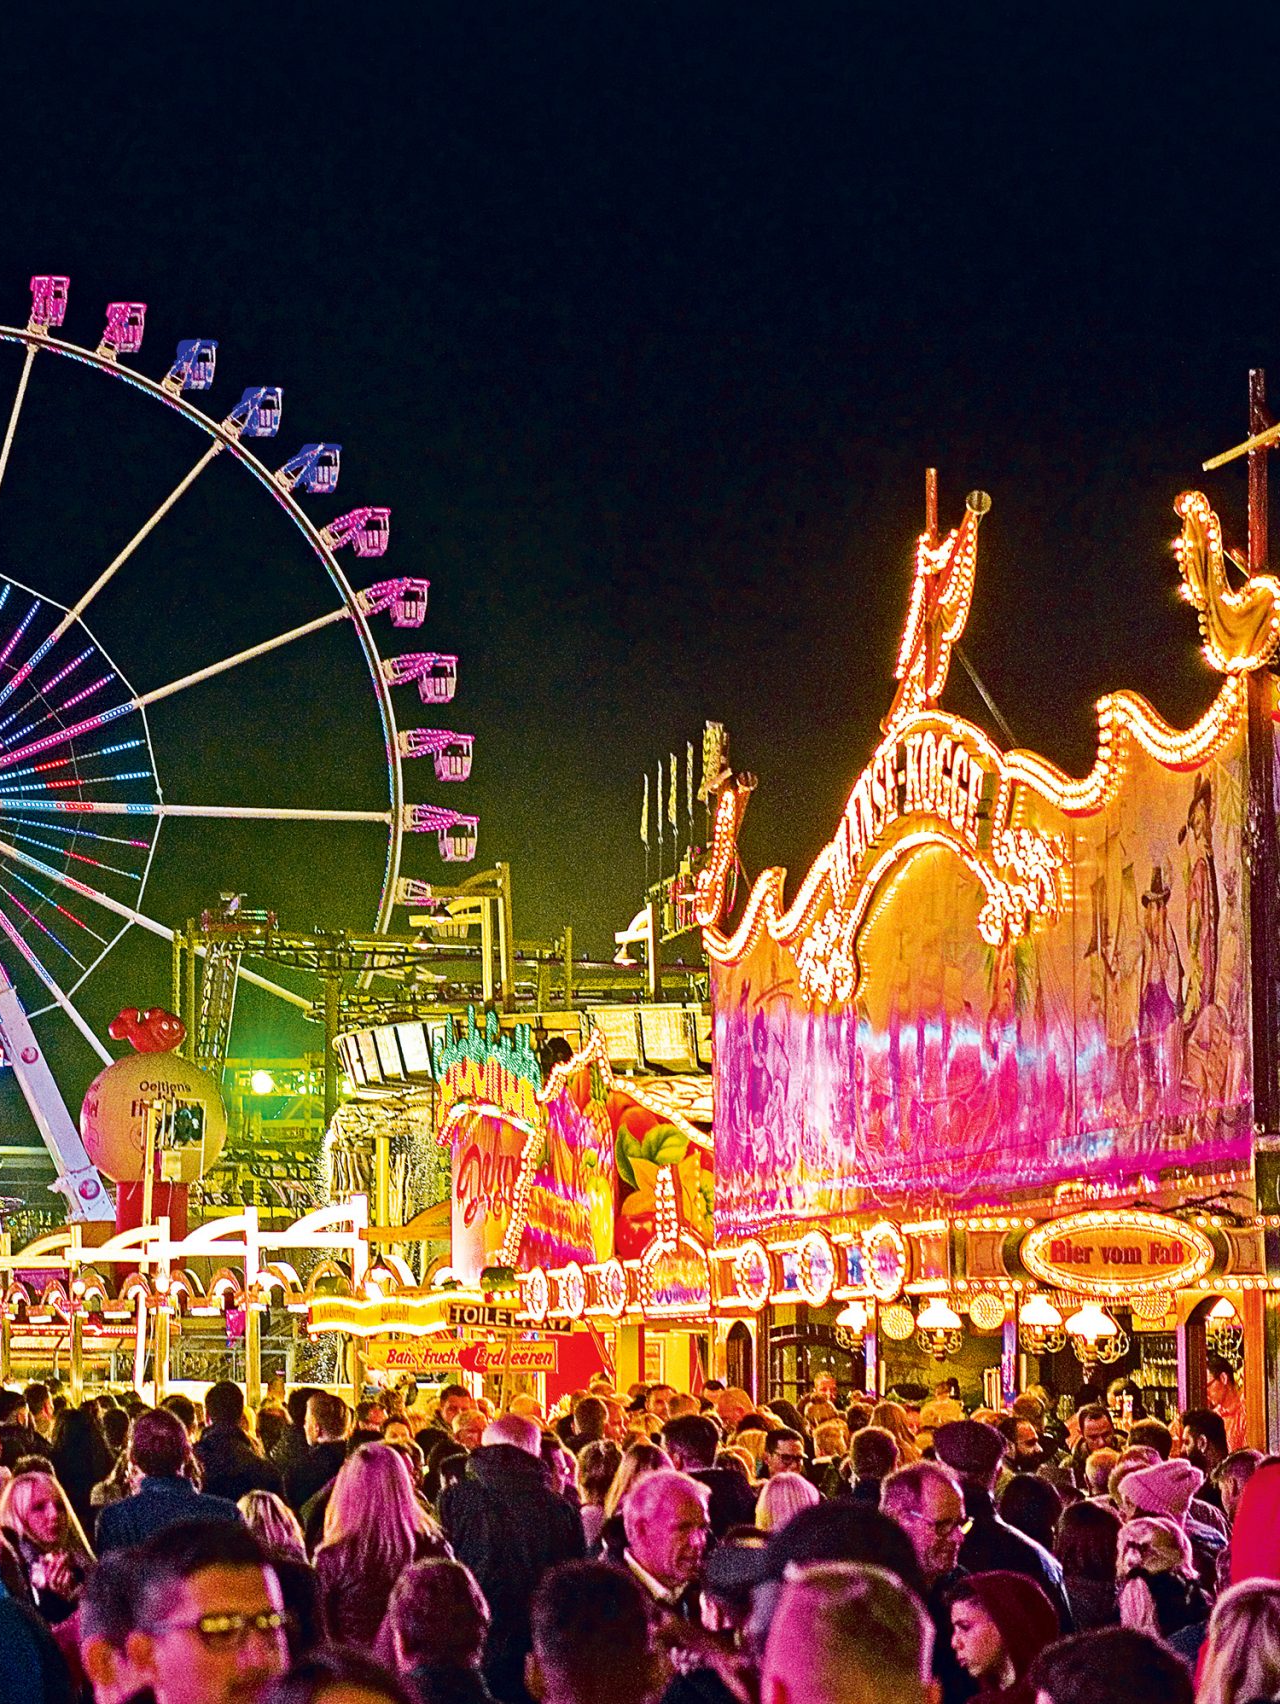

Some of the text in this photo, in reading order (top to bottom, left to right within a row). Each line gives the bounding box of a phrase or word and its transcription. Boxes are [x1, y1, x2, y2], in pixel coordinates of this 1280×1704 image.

[1050, 1239, 1184, 1264] Bier vom Faß
[475, 1347, 553, 1366] Erdeeren
